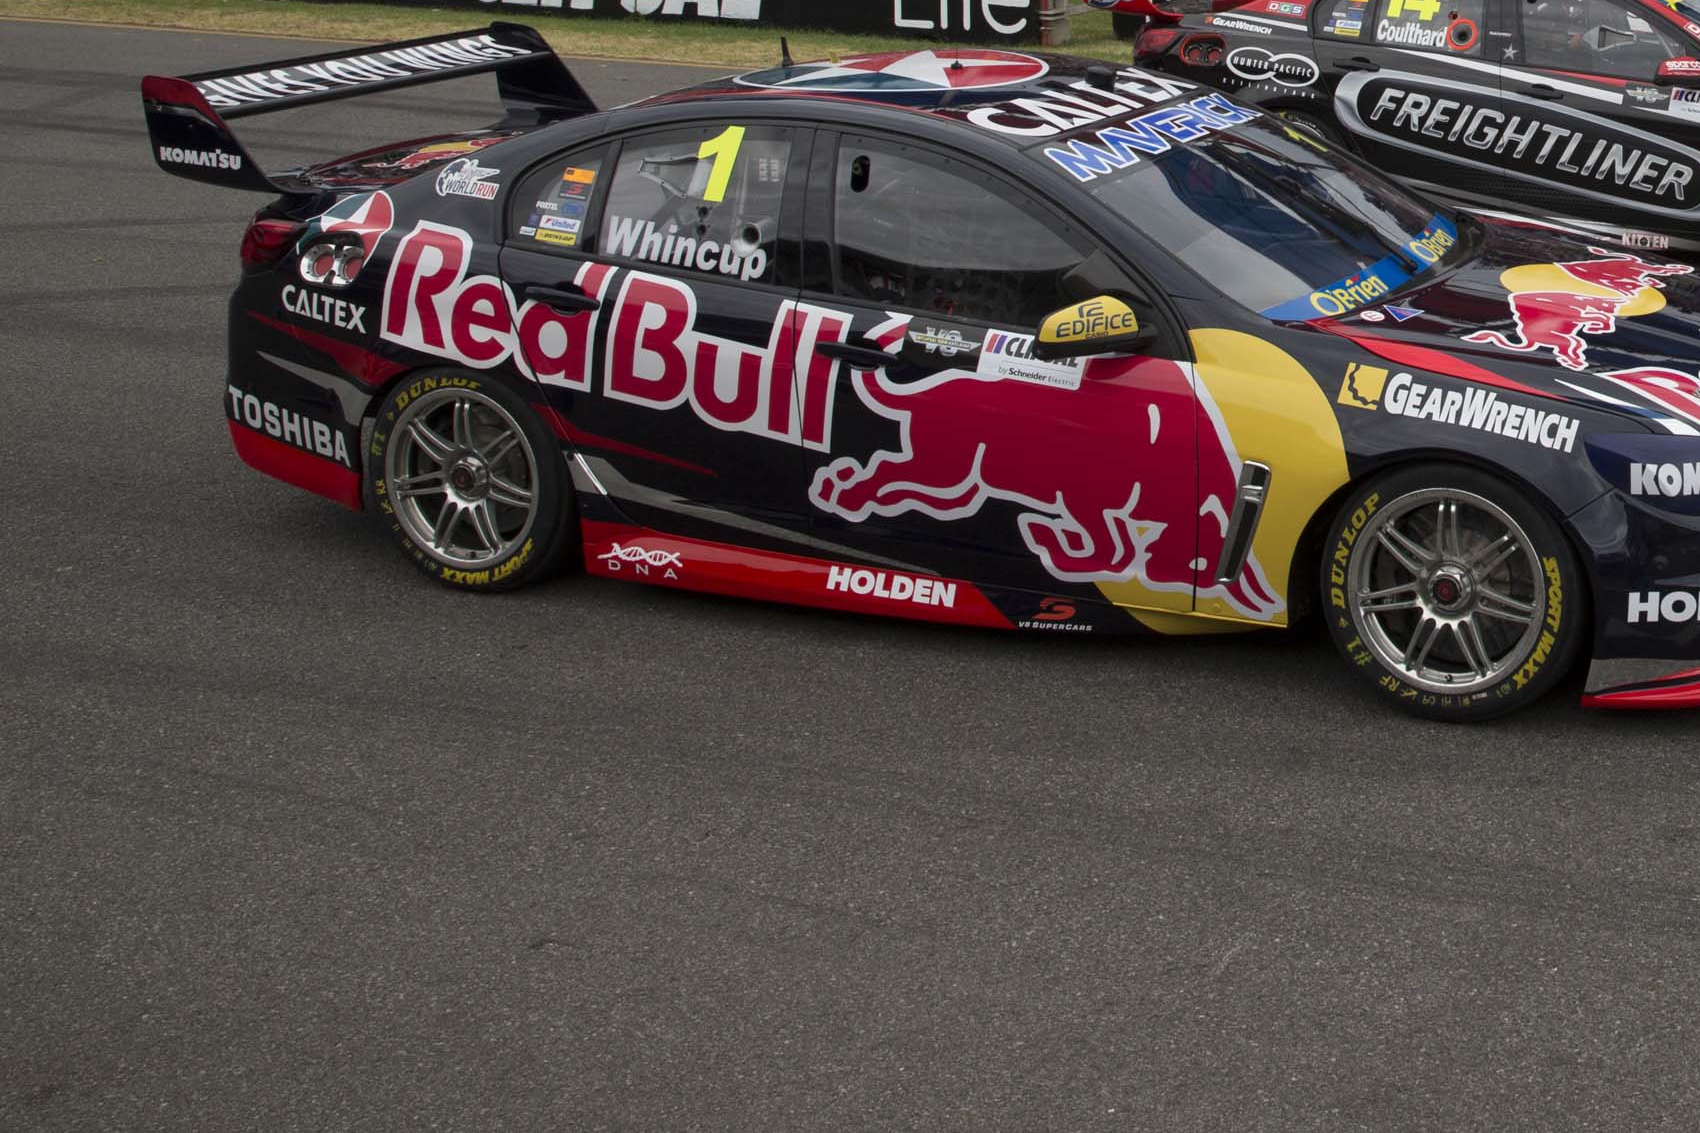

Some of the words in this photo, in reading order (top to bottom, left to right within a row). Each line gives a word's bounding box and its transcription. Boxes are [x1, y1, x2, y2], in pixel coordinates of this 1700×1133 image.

[1233, 55, 1269, 70] HUNTER
[1273, 63, 1313, 77] PACIFIC
[1376, 19, 1449, 48] Coulthard
[199, 69, 311, 107] GIVES
[299, 50, 413, 90] YOU
[389, 34, 532, 76] WINGS
[966, 68, 1199, 137] CALTEX
[159, 146, 242, 170] KOMATSU
[698, 126, 746, 202] 1
[1043, 92, 1265, 183] MAVERICK
[1369, 87, 1695, 201] FREIGHTLINER
[607, 214, 767, 283] Whincup
[282, 284, 367, 334] CALTEX
[1056, 311, 1134, 338] EDIFICE
[1008, 367, 1047, 382] Schneider
[228, 384, 351, 467] TOSHIBA
[1330, 492, 1381, 609] DUNLOP
[826, 565, 956, 608] HOLDEN
[1541, 556, 1563, 634] SPORT
[1511, 633, 1556, 691] MAXX
